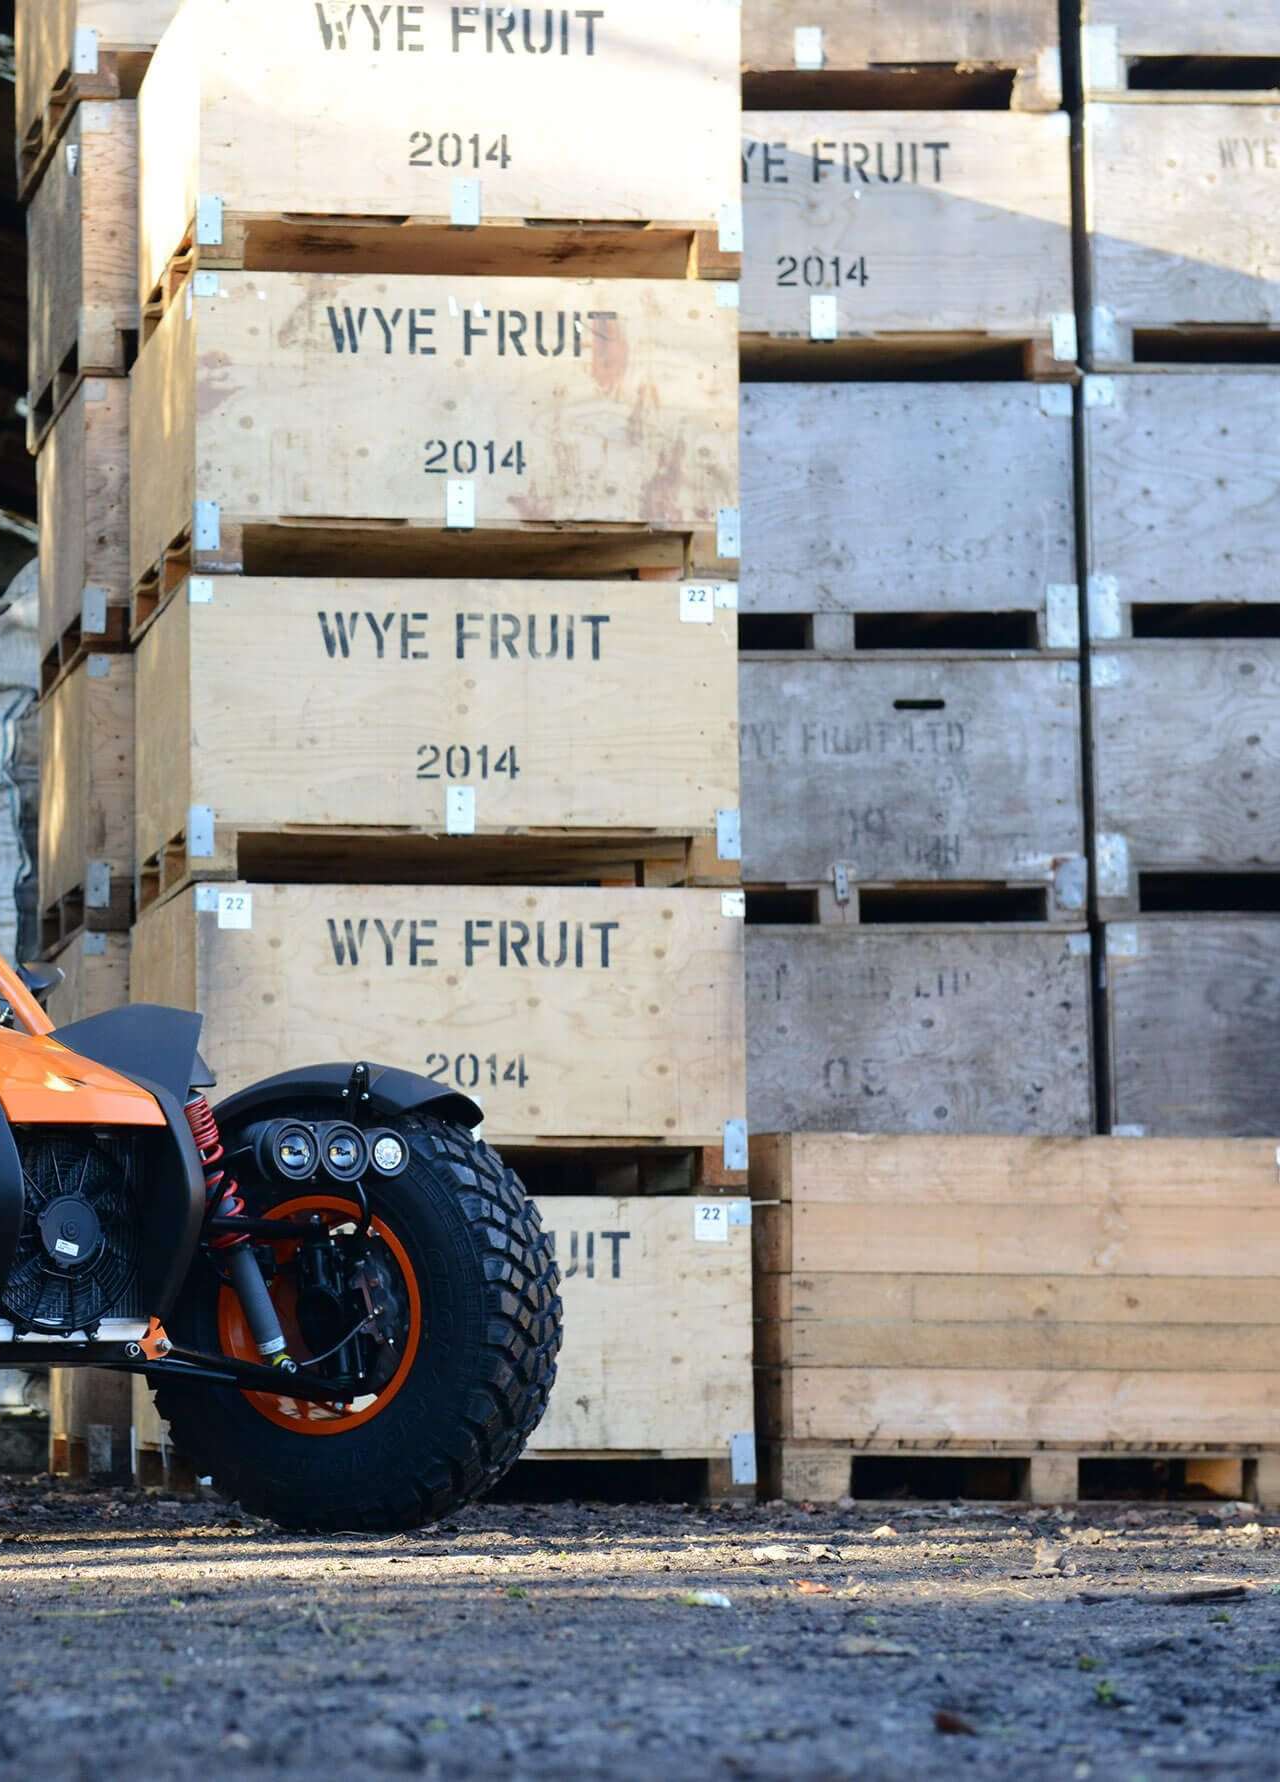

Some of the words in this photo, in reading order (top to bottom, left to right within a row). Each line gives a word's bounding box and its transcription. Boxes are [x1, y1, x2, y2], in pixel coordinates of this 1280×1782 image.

[316, 2, 425, 53] WYE
[451, 4, 606, 57] FRUIT
[409, 131, 513, 170] 2014
[741, 143, 789, 184] YE
[813, 142, 950, 185] FRUIT
[776, 255, 869, 289] 2014
[326, 305, 437, 357] WYE
[464, 310, 618, 358] FRUIT
[424, 439, 527, 476] 2014
[687, 589, 707, 602] 22
[318, 610, 430, 661] WYE
[456, 612, 611, 661] FRUIT
[416, 744, 521, 781] 2014
[225, 898, 245, 911] 22
[327, 919, 439, 968] WYE
[464, 920, 620, 969] FRUIT
[425, 1053, 530, 1089] 2014
[701, 1206, 722, 1221] 22
[546, 1230, 631, 1279] UIT
